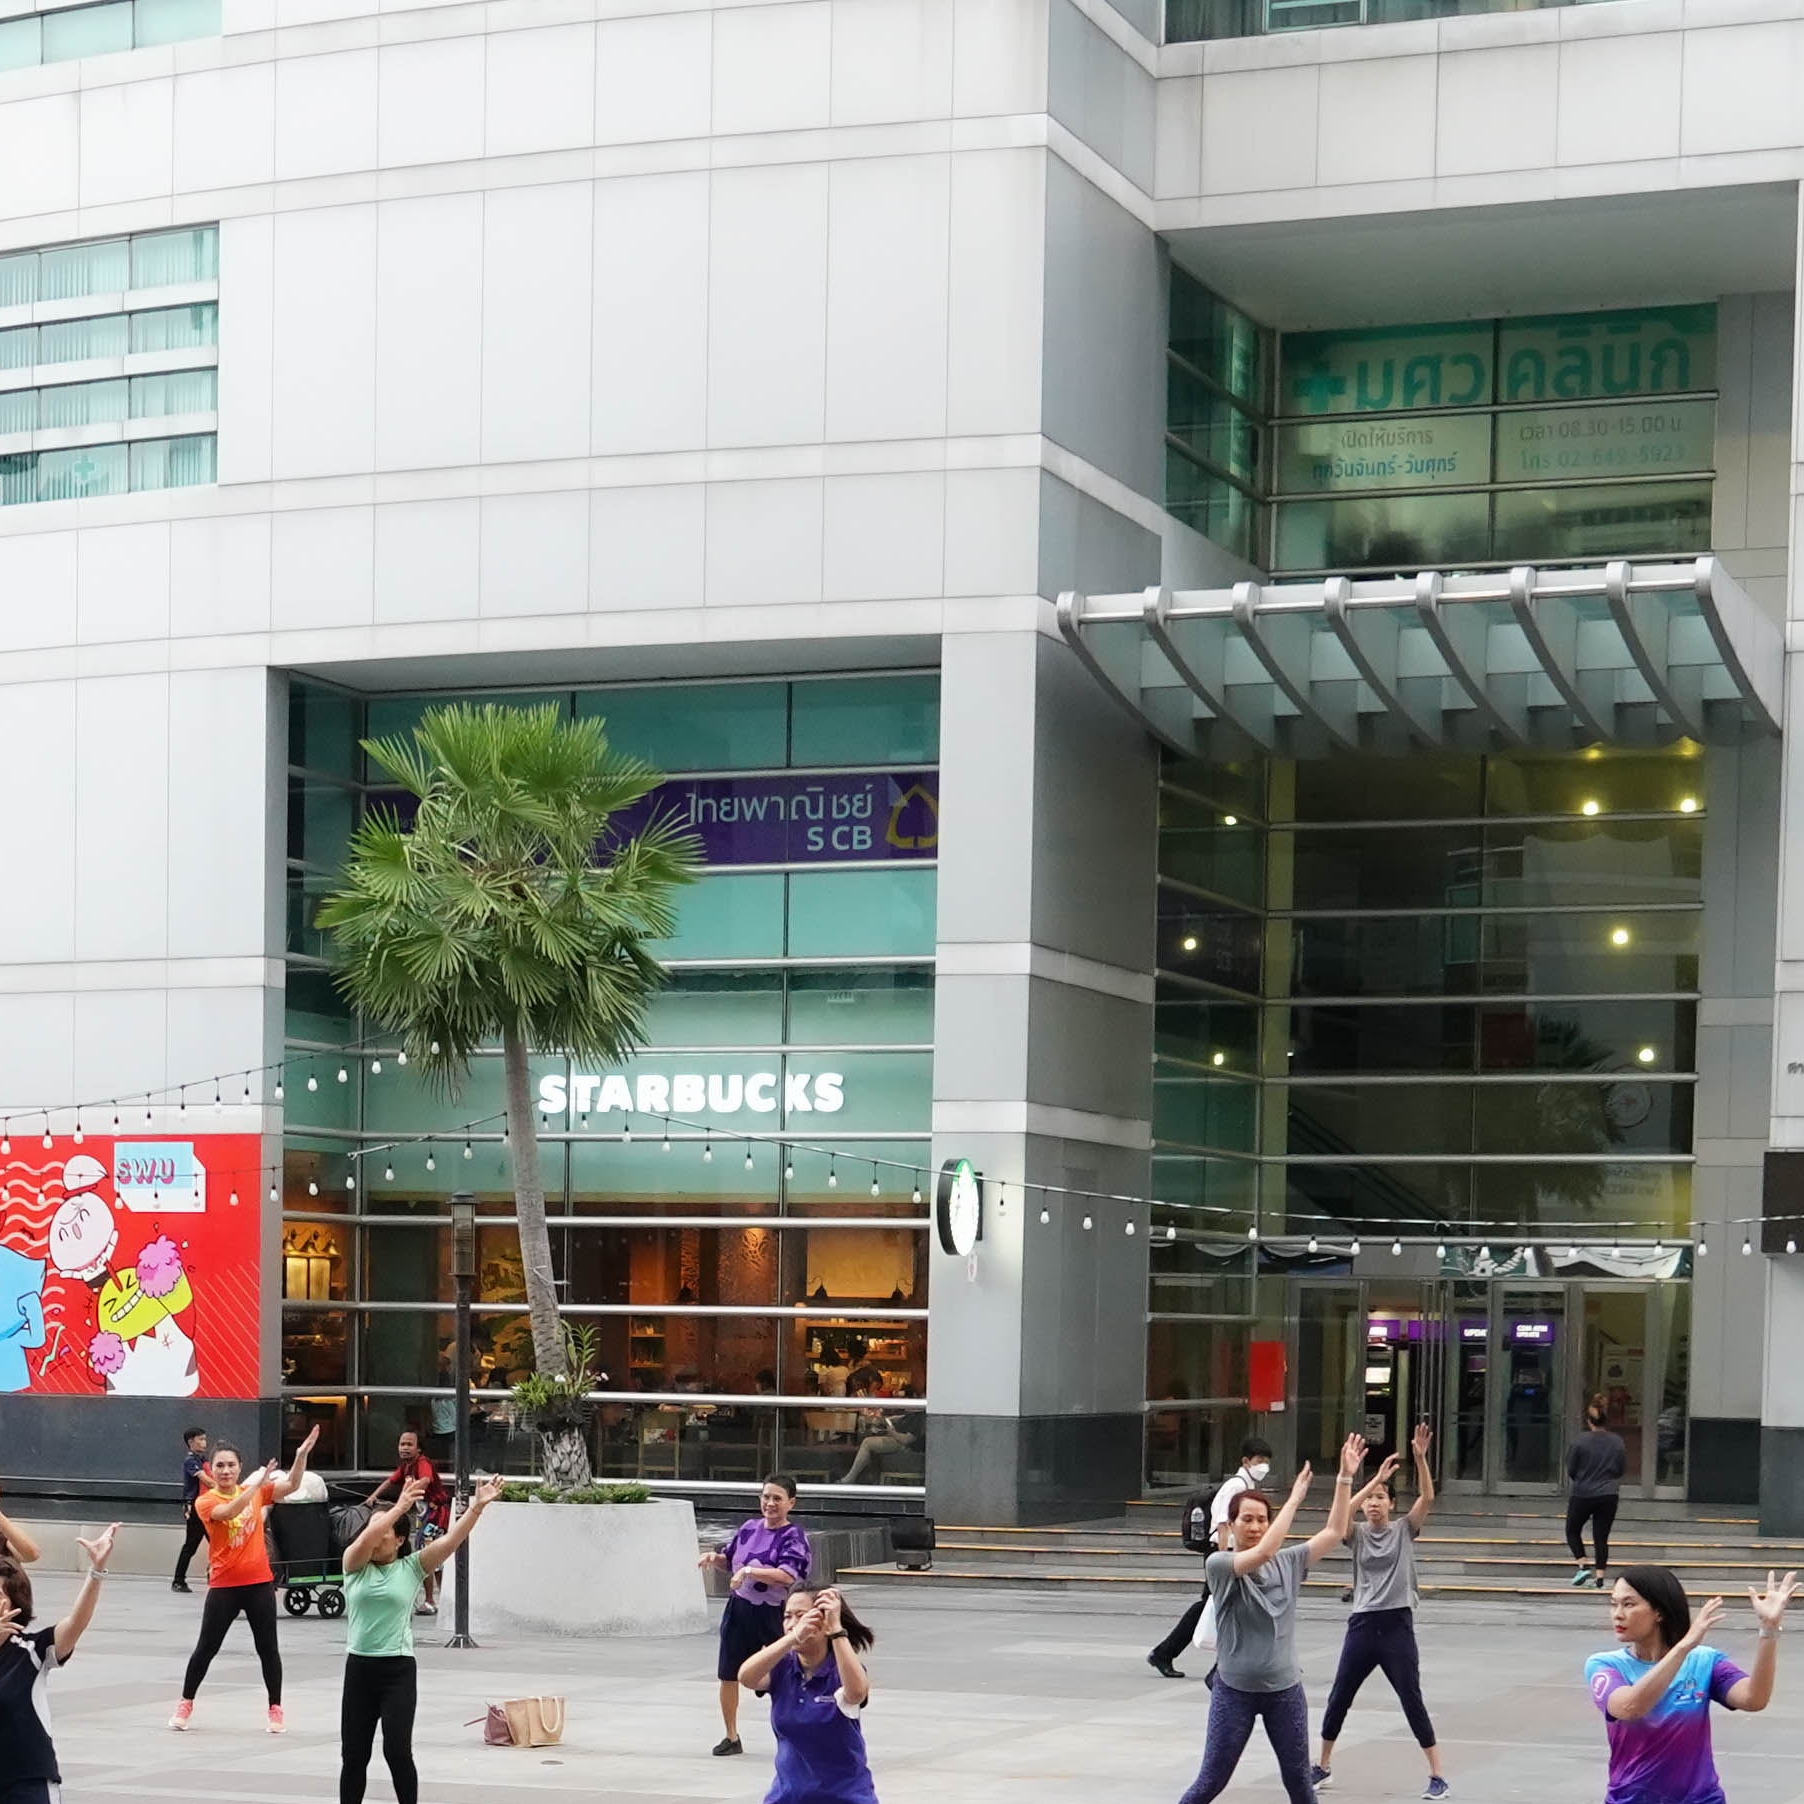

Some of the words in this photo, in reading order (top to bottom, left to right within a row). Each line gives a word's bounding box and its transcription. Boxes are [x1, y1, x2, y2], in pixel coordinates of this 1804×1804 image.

[1506, 323, 1690, 400] คลินิก
[807, 825, 873, 851] SCB
[538, 1073, 844, 1113] STARBUCKS
[116, 1158, 175, 1185] SWU
